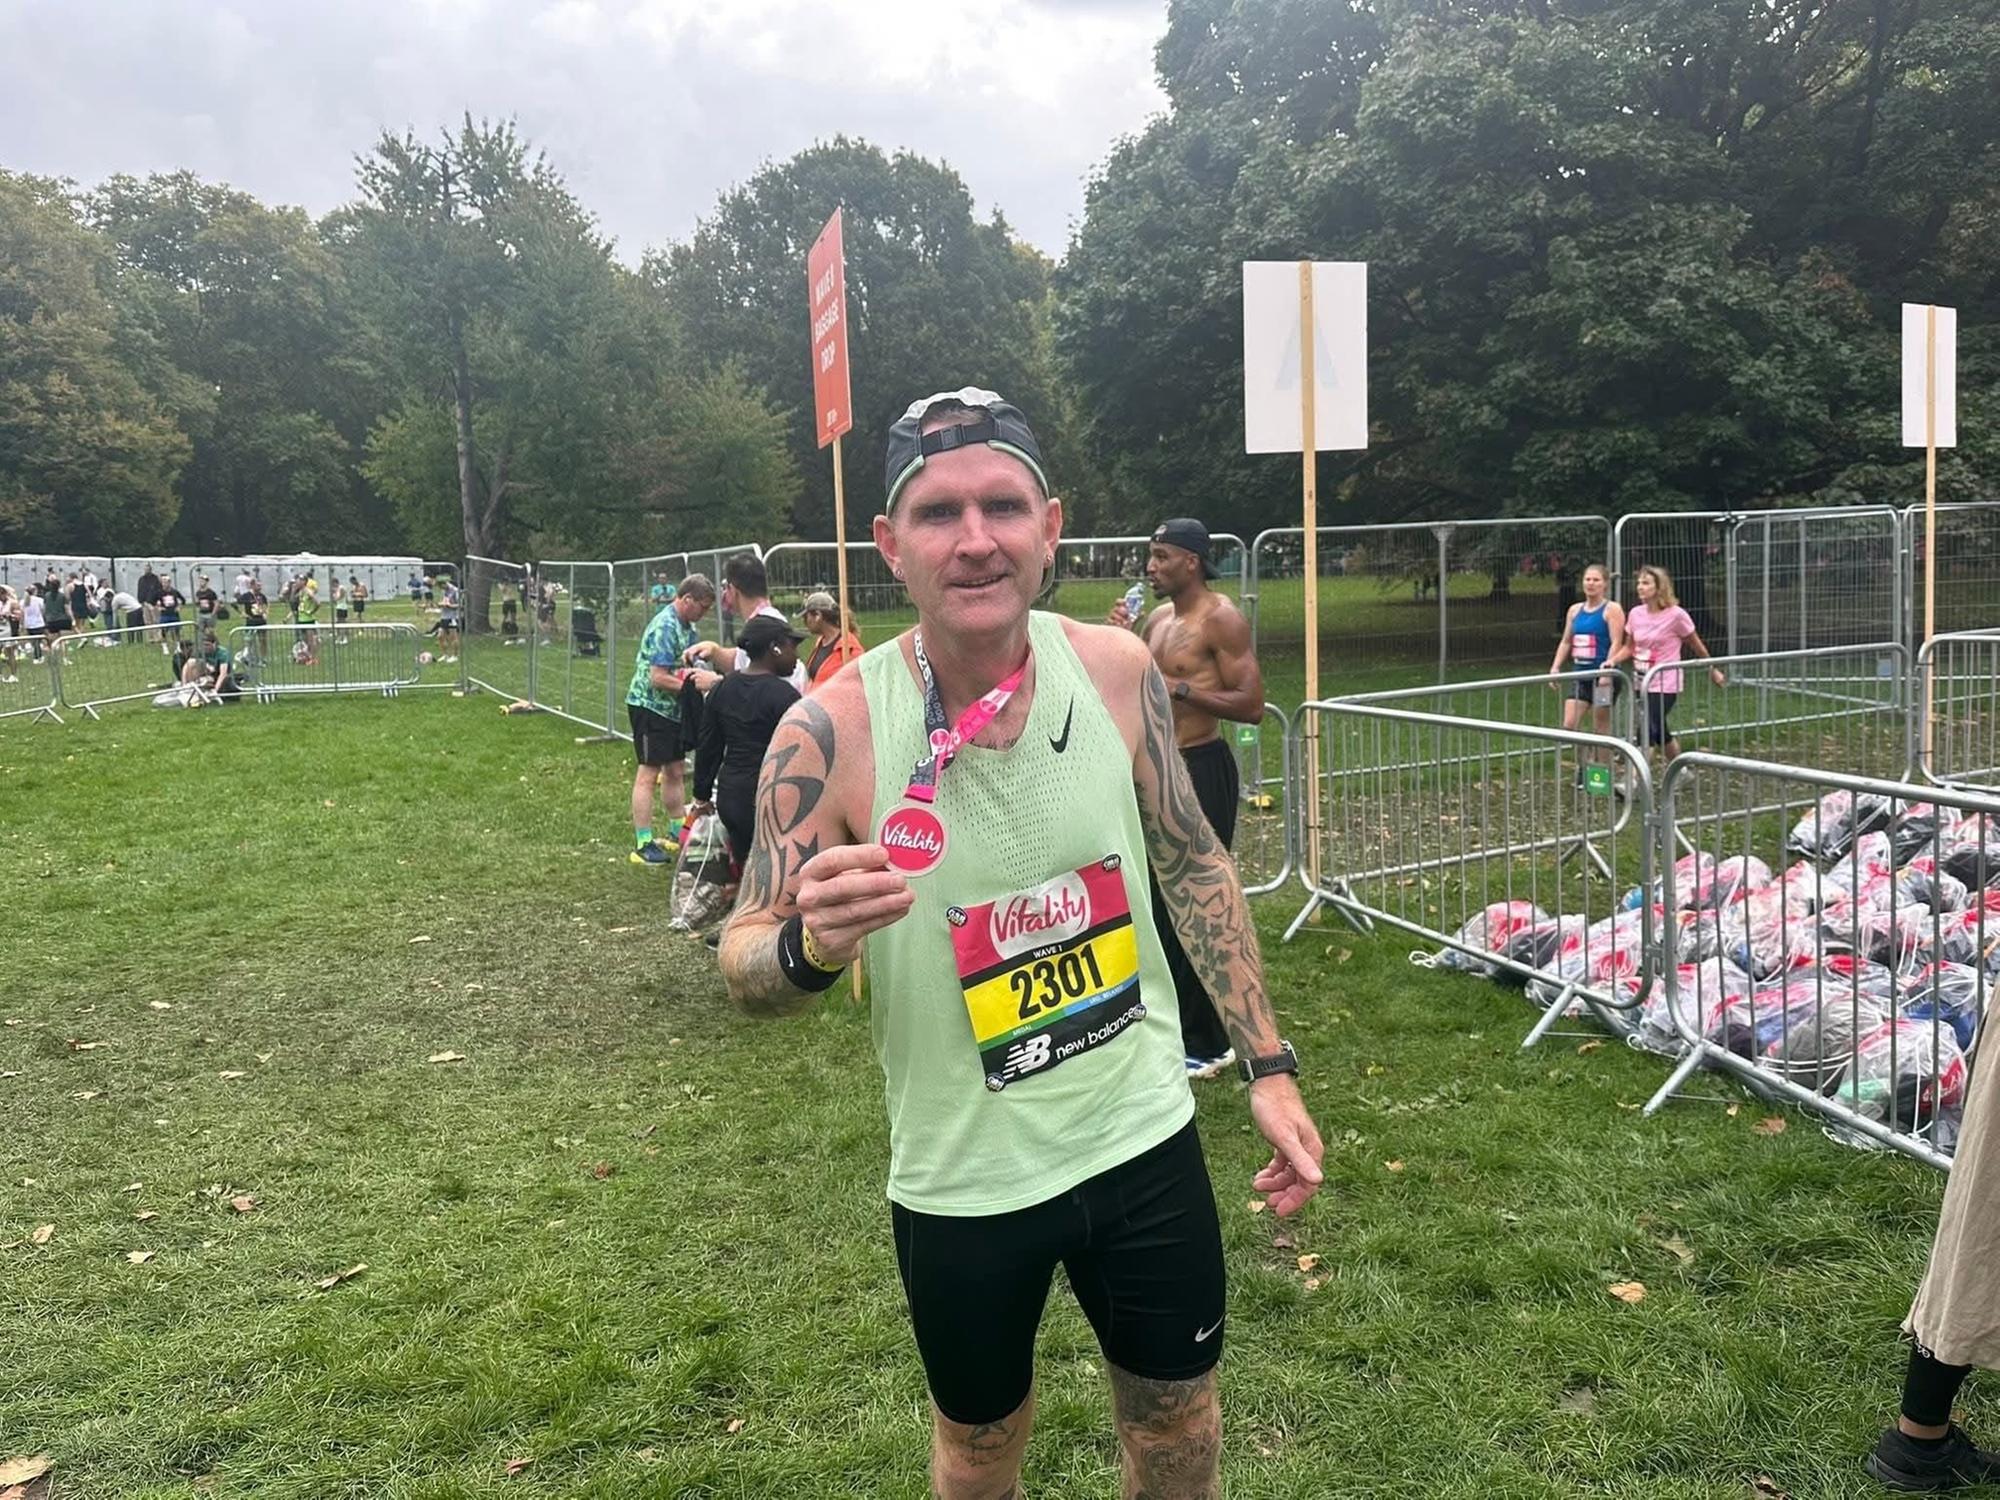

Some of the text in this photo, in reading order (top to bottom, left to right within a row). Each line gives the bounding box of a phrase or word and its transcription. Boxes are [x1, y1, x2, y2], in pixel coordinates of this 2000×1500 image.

[884, 821, 942, 858] Vitality
[993, 887, 1087, 943] Vitality
[1033, 946, 1057, 959] WAVE
[1010, 942, 1104, 1021] 2301
[1055, 1036, 1086, 1060] new
[1087, 1007, 1134, 1046] balance
